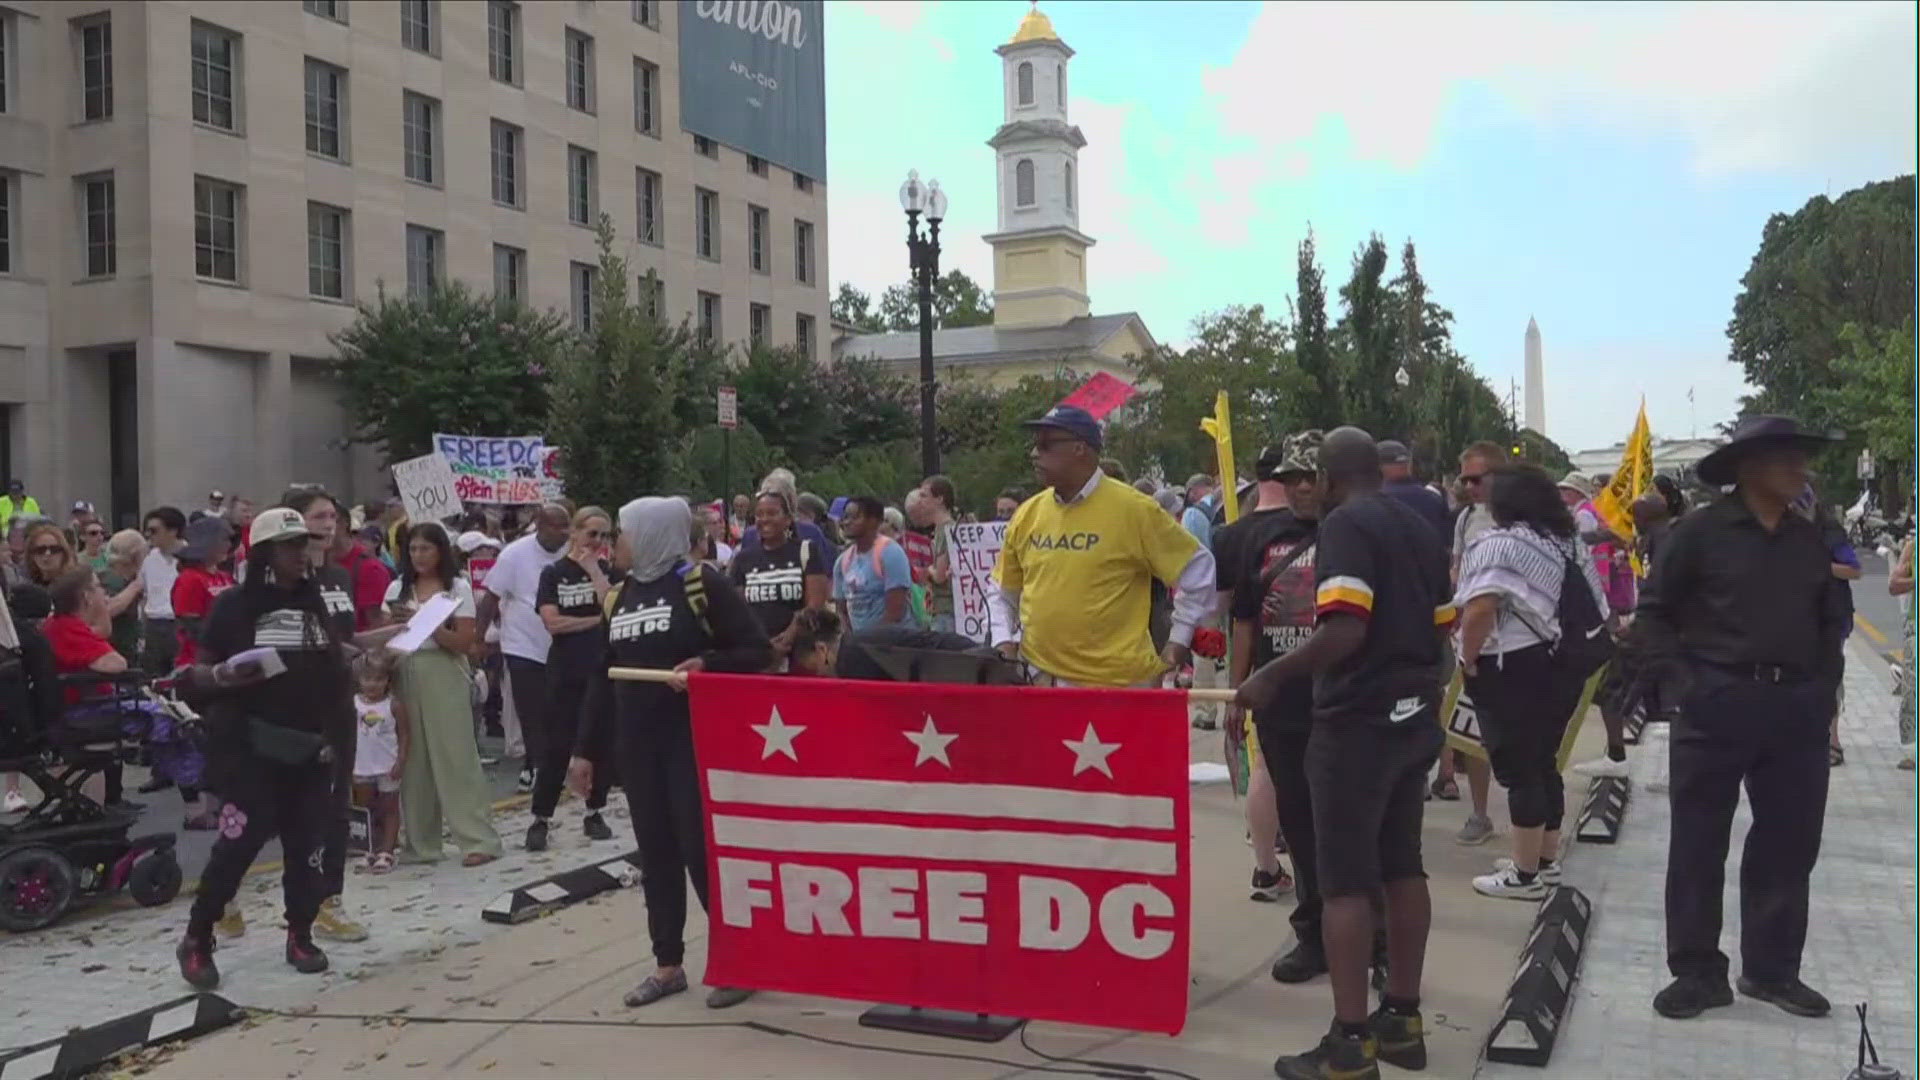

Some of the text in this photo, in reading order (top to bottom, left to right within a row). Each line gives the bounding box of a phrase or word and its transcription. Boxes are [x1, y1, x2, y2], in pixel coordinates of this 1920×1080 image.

[729, 60, 777, 90] AFL-CIO
[438, 437, 506, 467] FREE
[409, 484, 448, 510] YOU
[950, 525, 984, 544] KEEP
[1029, 532, 1100, 550] NAACP
[957, 548, 1000, 571] FILT
[745, 584, 778, 603] FREE
[644, 618, 671, 634] DC
[717, 856, 1175, 960] FREE DC
